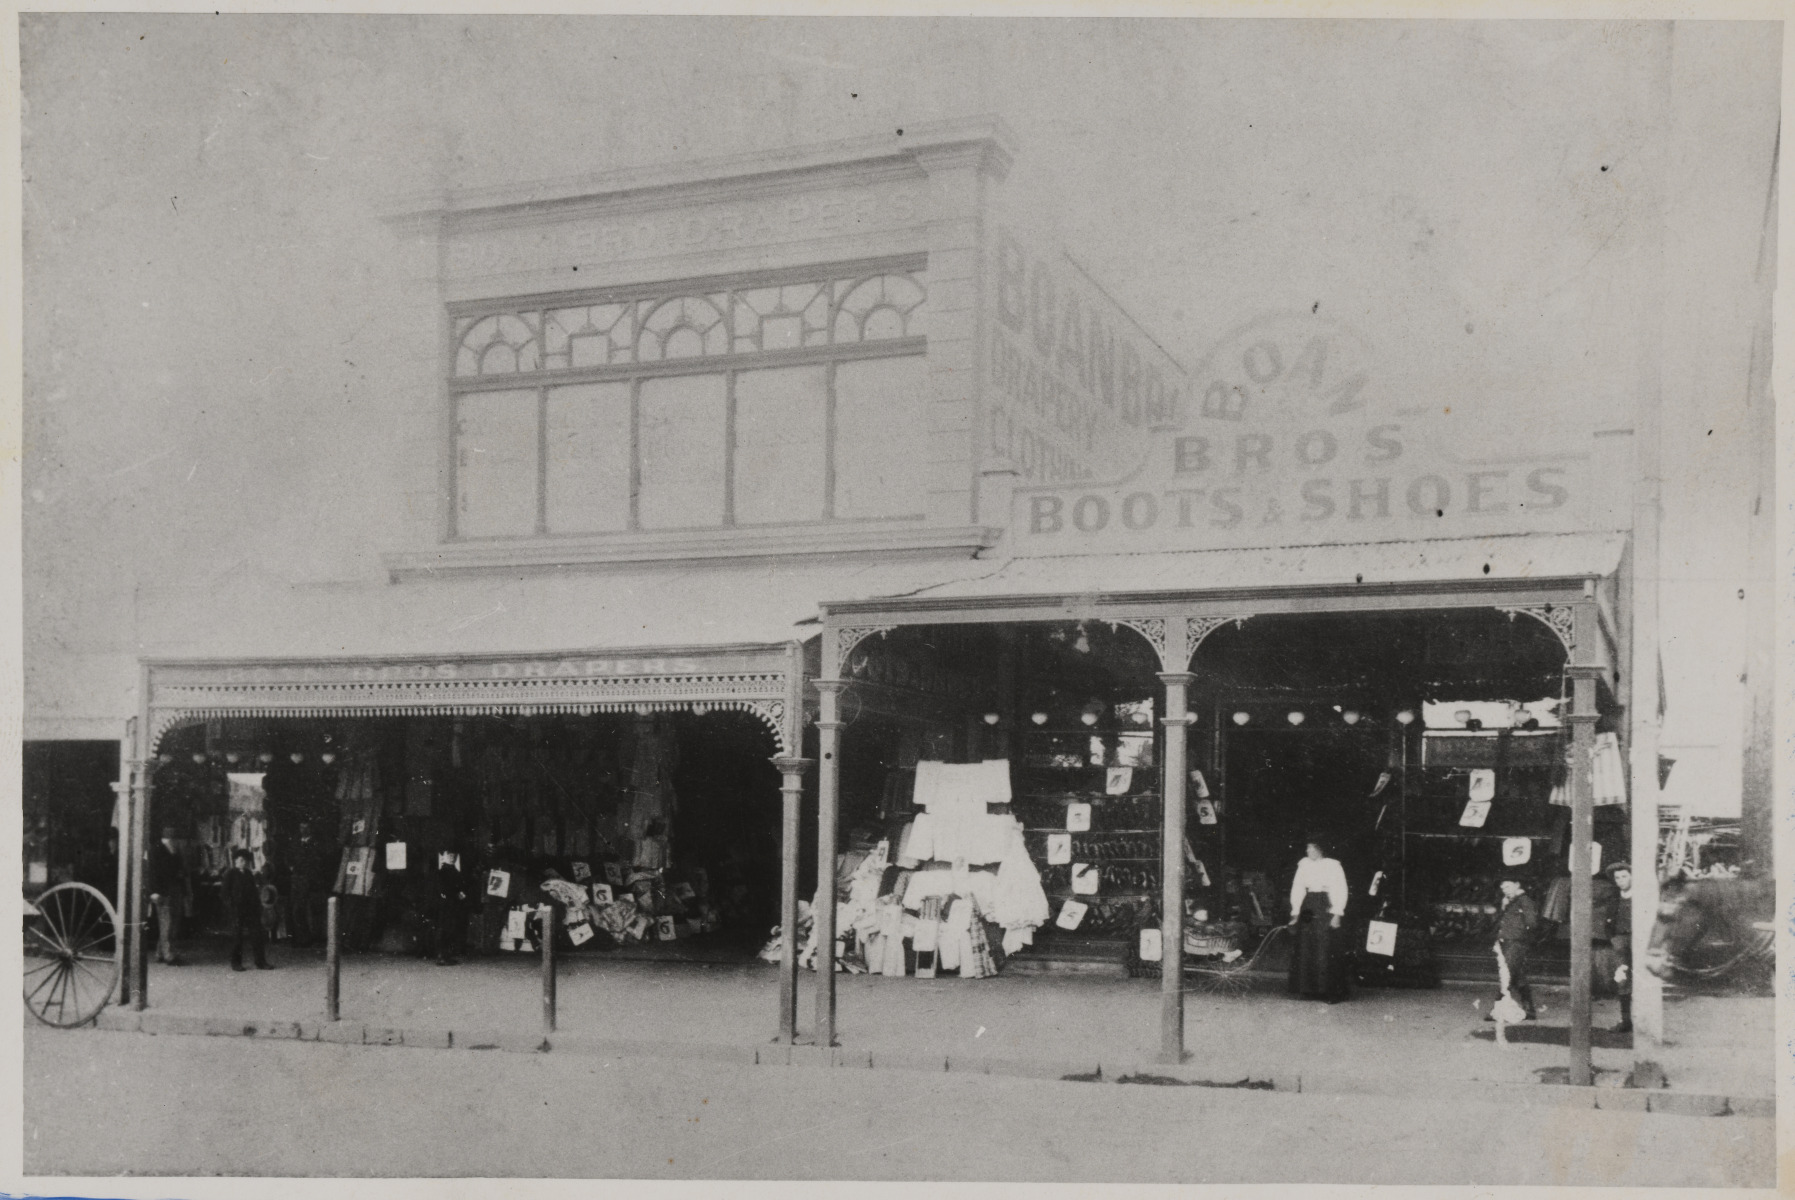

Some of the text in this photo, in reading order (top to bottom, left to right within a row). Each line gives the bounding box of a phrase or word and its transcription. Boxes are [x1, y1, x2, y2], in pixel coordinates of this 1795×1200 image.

[680, 186, 918, 246] DRAPERS
[997, 234, 1115, 410] BOAN
[1202, 336, 1369, 422] BOAN
[1173, 423, 1403, 475] BROS
[1028, 467, 1571, 535] BOOTS & SHOES
[352, 662, 457, 680] BROS
